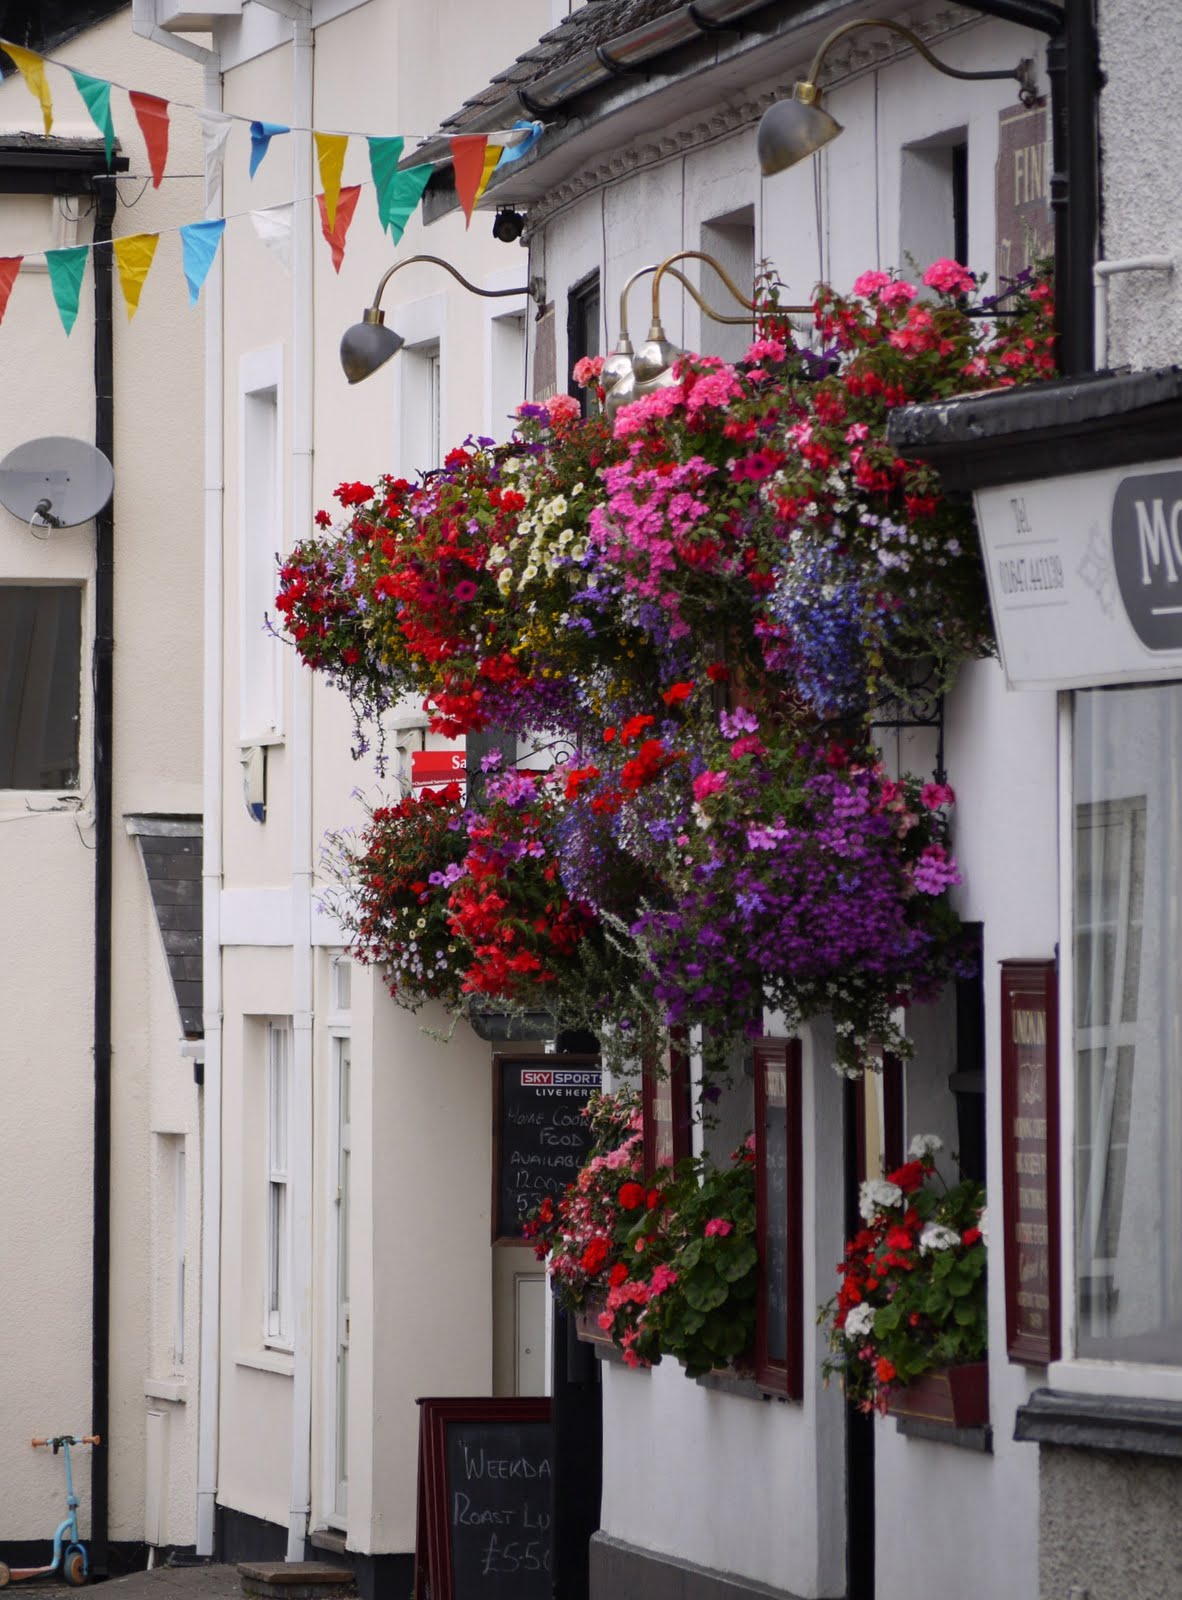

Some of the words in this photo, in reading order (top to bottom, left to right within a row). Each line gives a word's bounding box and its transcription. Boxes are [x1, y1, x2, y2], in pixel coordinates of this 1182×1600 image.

[451, 755, 467, 769] Sa
[524, 1073, 550, 1083] SKY
[535, 1088, 562, 1097] LIVE
[552, 1105, 590, 1127] COOK
[510, 1151, 586, 1168] AVAILABL
[465, 1447, 551, 1480] WEEKDA
[454, 1491, 516, 1525] ROAST
[523, 1502, 551, 1530] LU
[480, 1532, 551, 1575] £5.5
